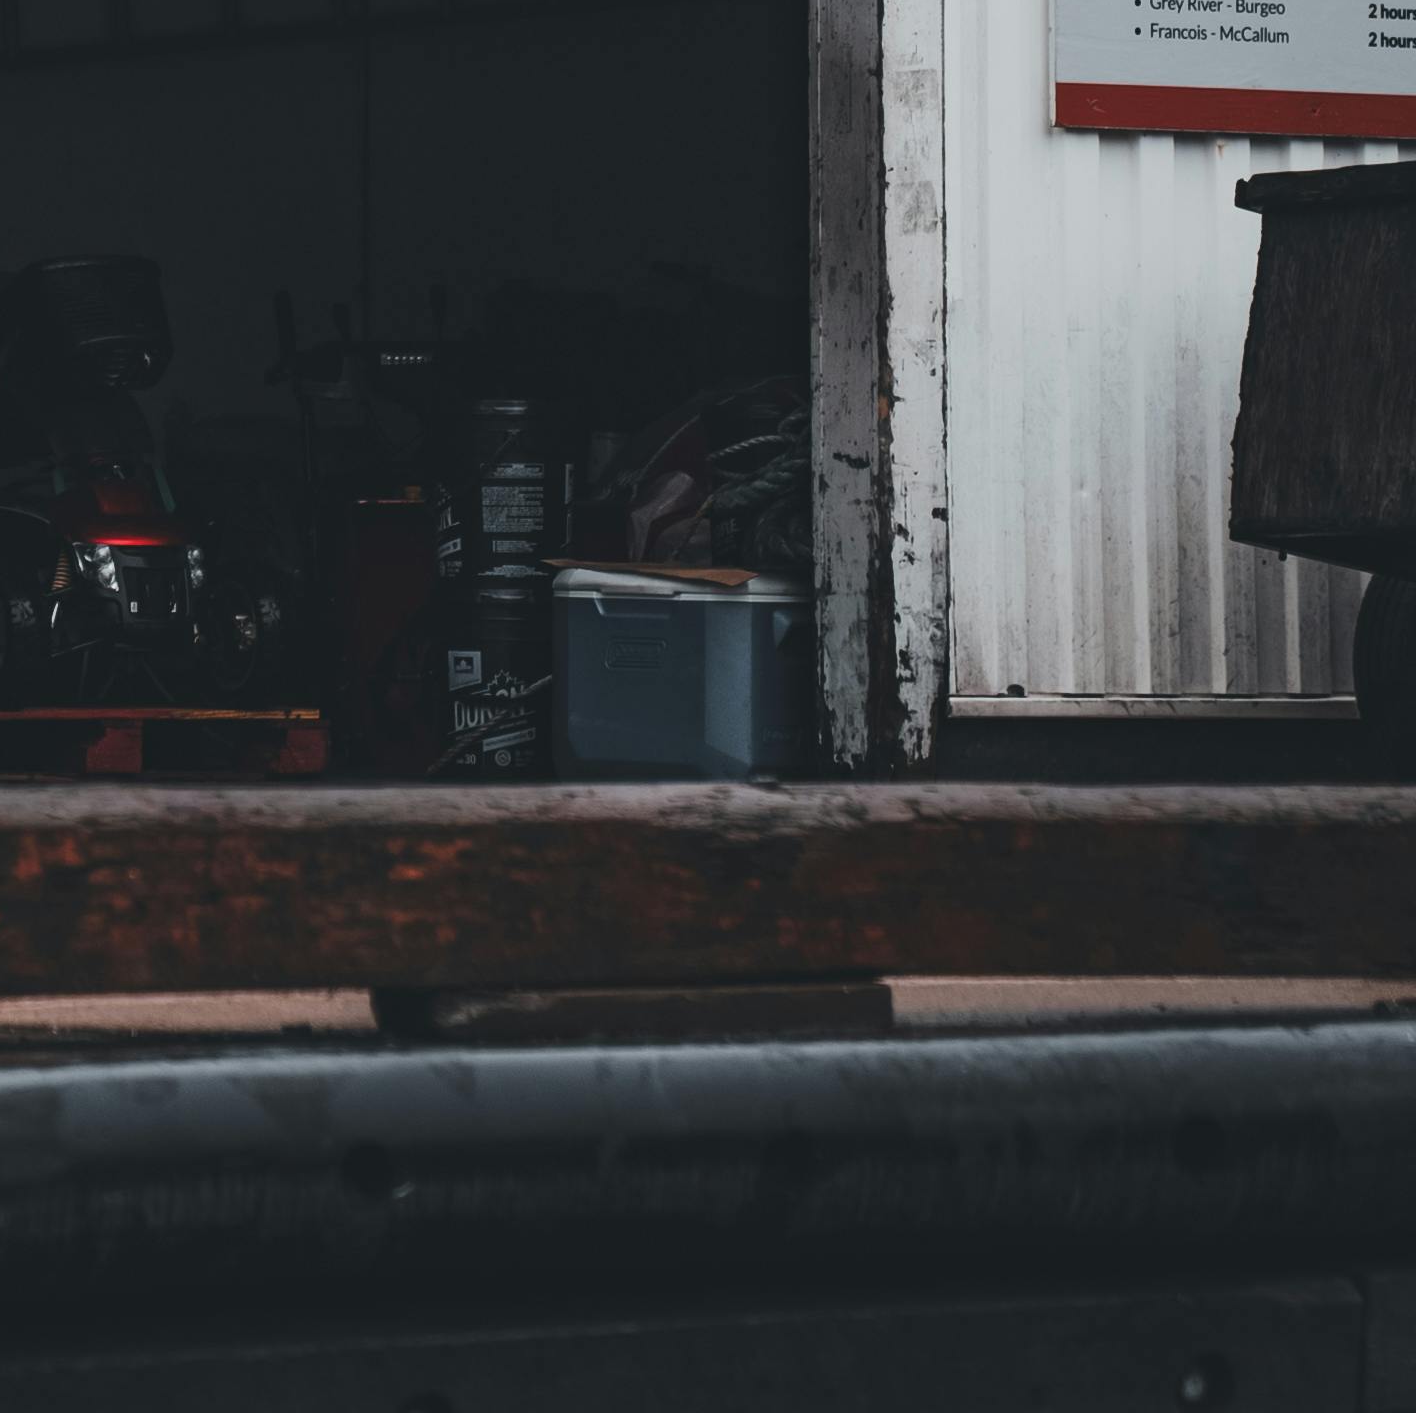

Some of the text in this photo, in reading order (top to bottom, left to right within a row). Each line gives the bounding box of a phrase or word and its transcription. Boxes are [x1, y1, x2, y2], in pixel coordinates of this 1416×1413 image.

[1368, 3, 1377, 19] 2
[1149, 23, 1207, 41] Francois
[1219, 25, 1289, 44] McCallum
[1368, 32, 1377, 48] 2
